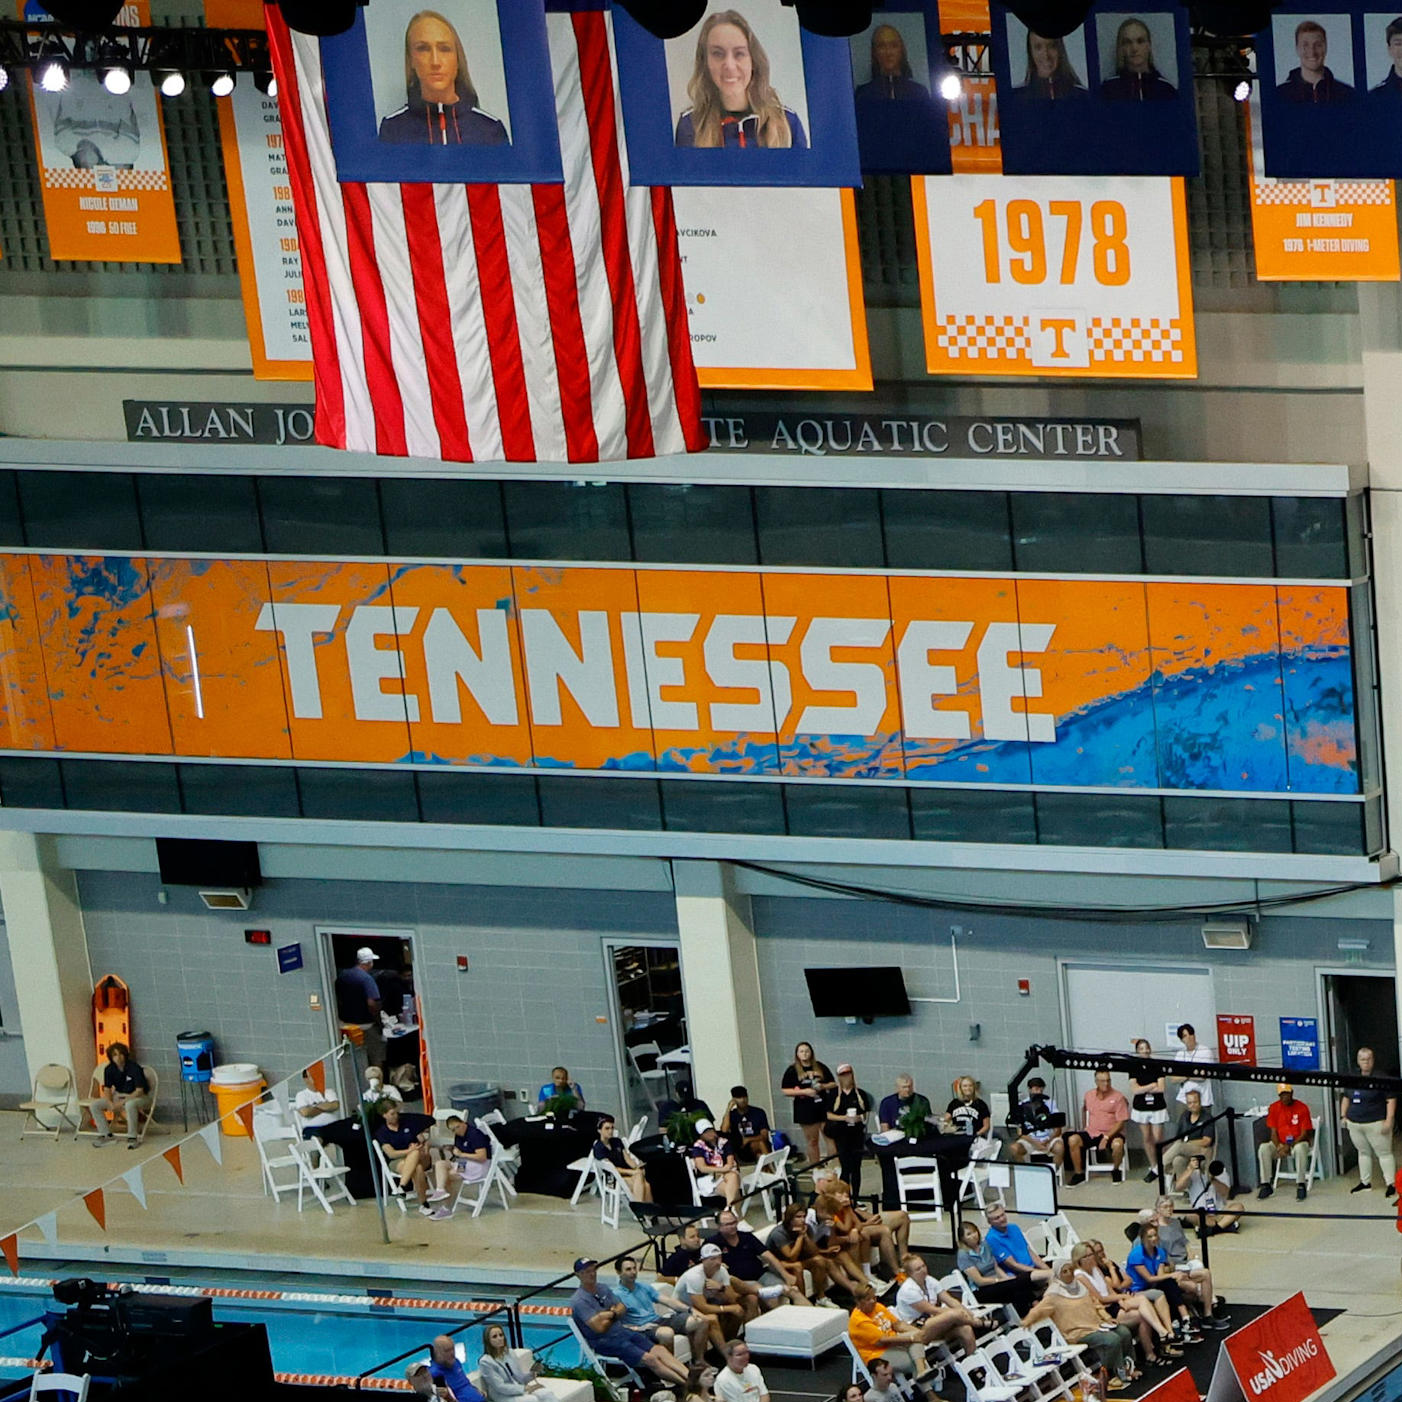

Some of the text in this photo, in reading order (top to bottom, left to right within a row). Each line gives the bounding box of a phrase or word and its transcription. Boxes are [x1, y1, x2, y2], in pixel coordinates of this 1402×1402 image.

[973, 199, 1131, 285] 1978
[1340, 239, 1370, 253] DIVING
[136, 405, 256, 439] ALLAN
[770, 418, 949, 455] AQUATIC
[967, 422, 1125, 457] CENTER
[255, 602, 1058, 744] TENNESSEE
[1249, 1338, 1319, 1396] USA DIVING
